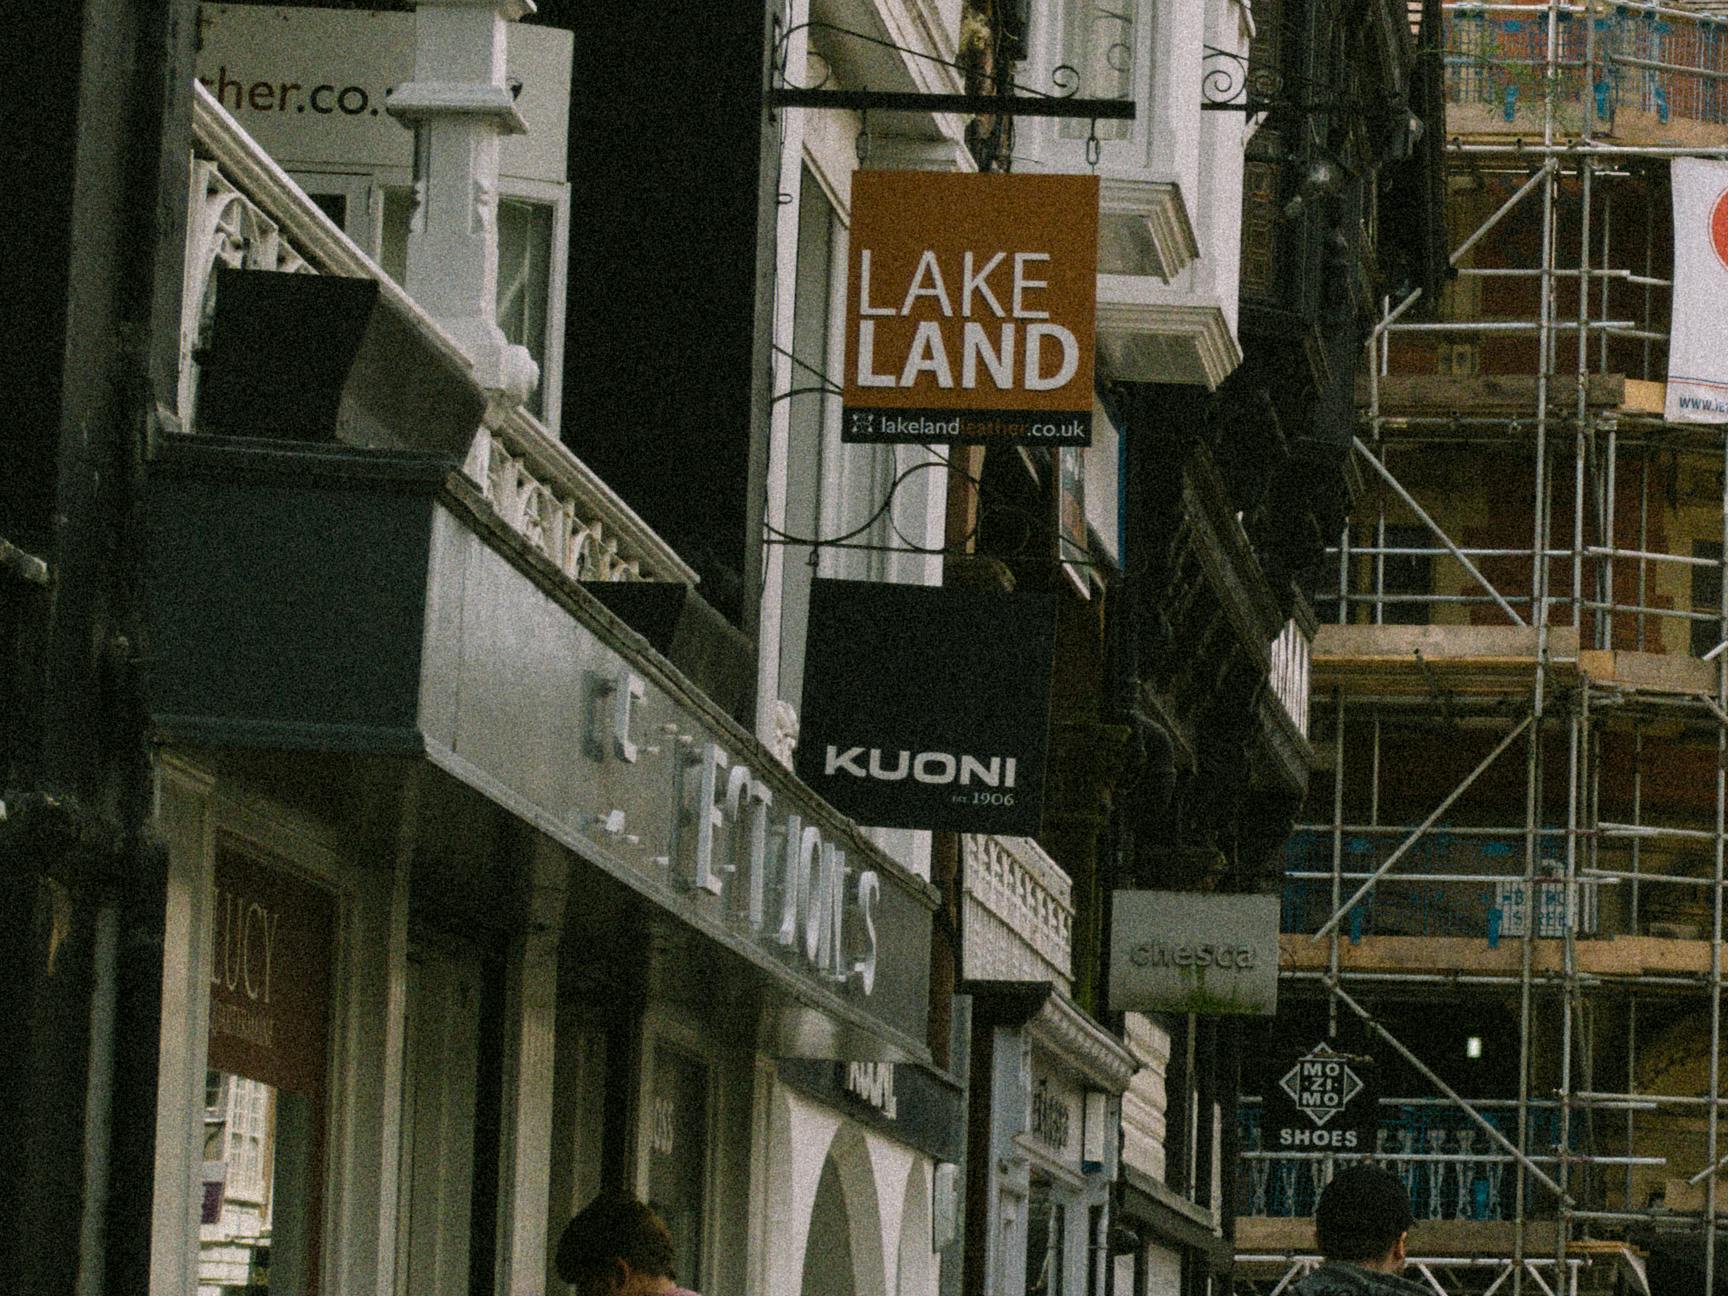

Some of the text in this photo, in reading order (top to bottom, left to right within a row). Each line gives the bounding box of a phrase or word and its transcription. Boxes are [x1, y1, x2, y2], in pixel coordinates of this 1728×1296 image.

[859, 248, 1050, 319] LAKE
[857, 319, 1080, 391] LAND
[824, 744, 1017, 788] KUONI
[972, 791, 1015, 807] 1906
[1129, 942, 1254, 970] chesca
[1303, 1063, 1341, 1077] MO
[1301, 1092, 1340, 1106] MO
[1280, 1128, 1358, 1148] SHOES
